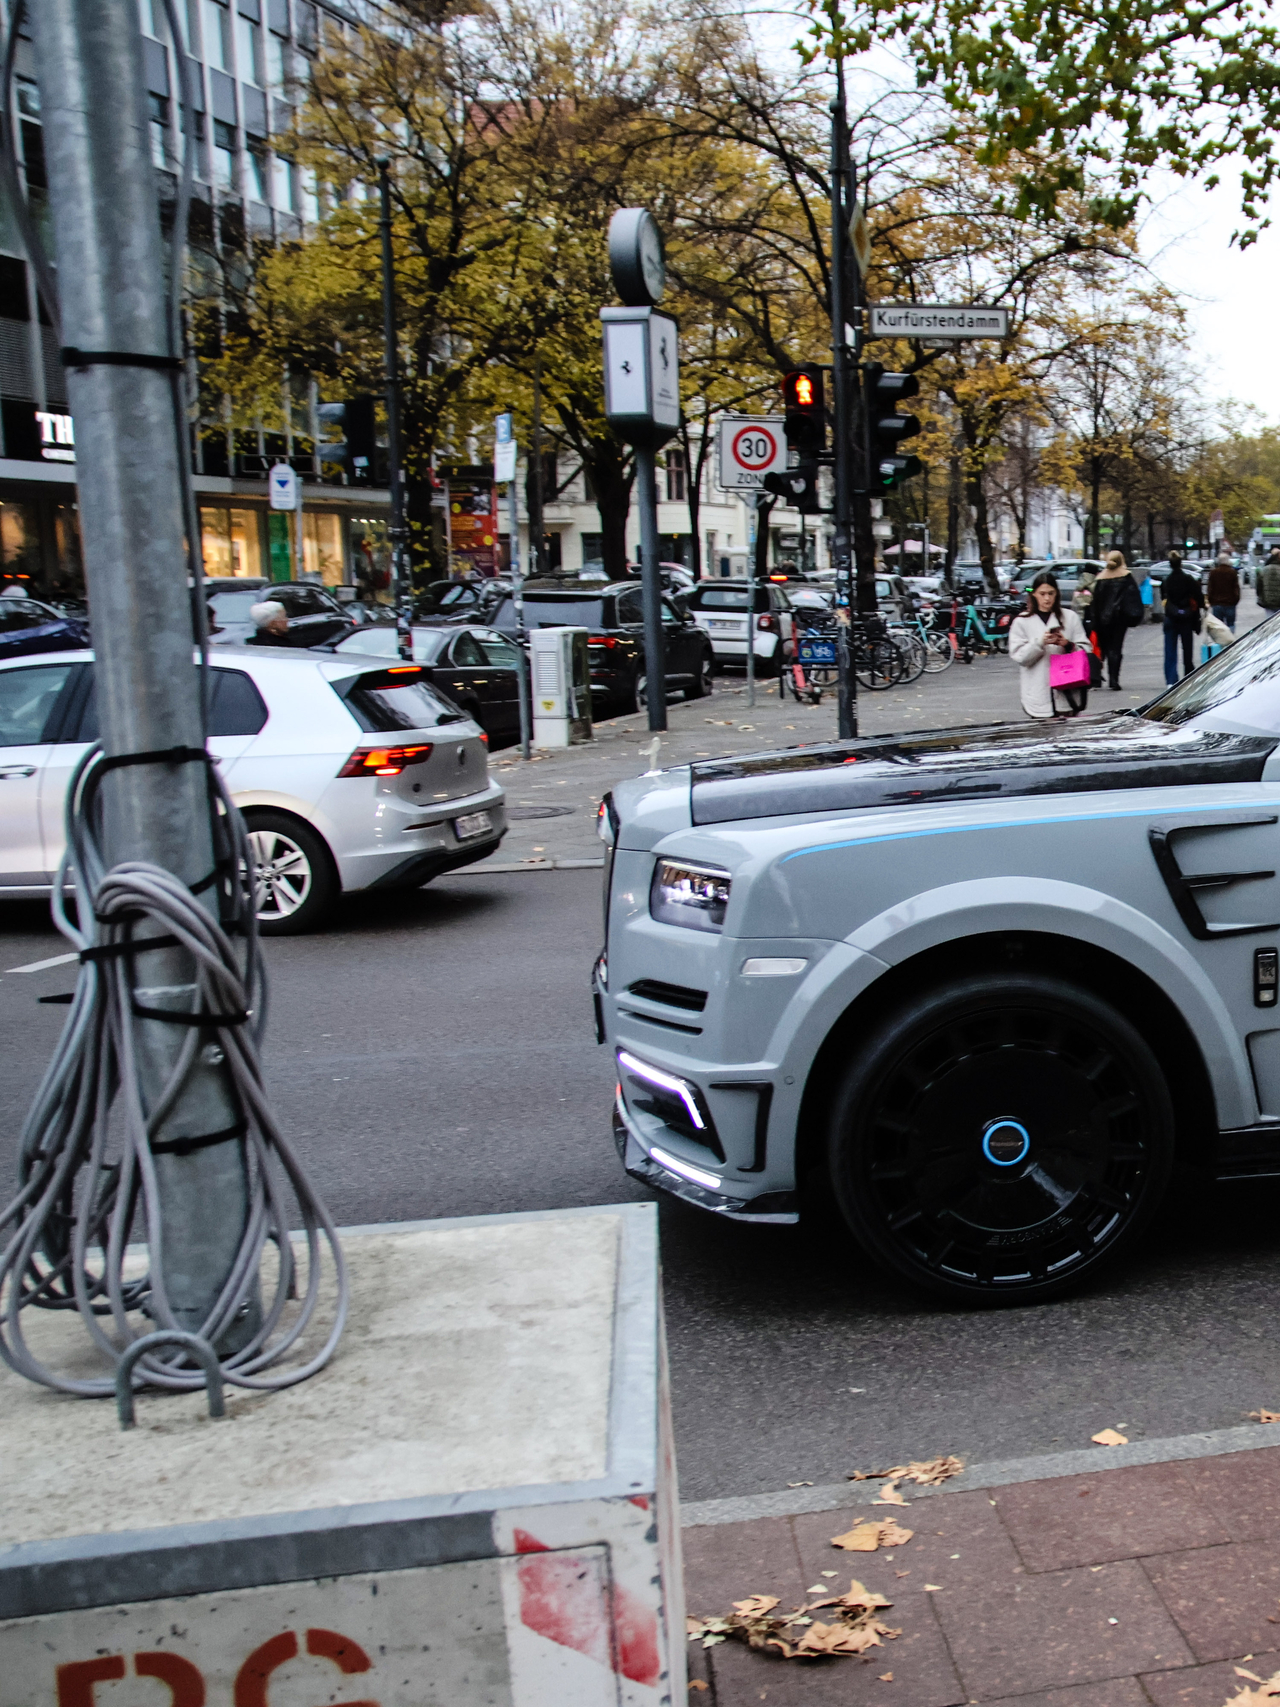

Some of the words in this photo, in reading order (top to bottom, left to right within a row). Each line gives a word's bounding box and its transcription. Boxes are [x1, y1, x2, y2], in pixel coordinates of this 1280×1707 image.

[876, 310, 1000, 328] Kurfürstendamm
[741, 437, 767, 458] 30
[737, 472, 765, 485] ZON
